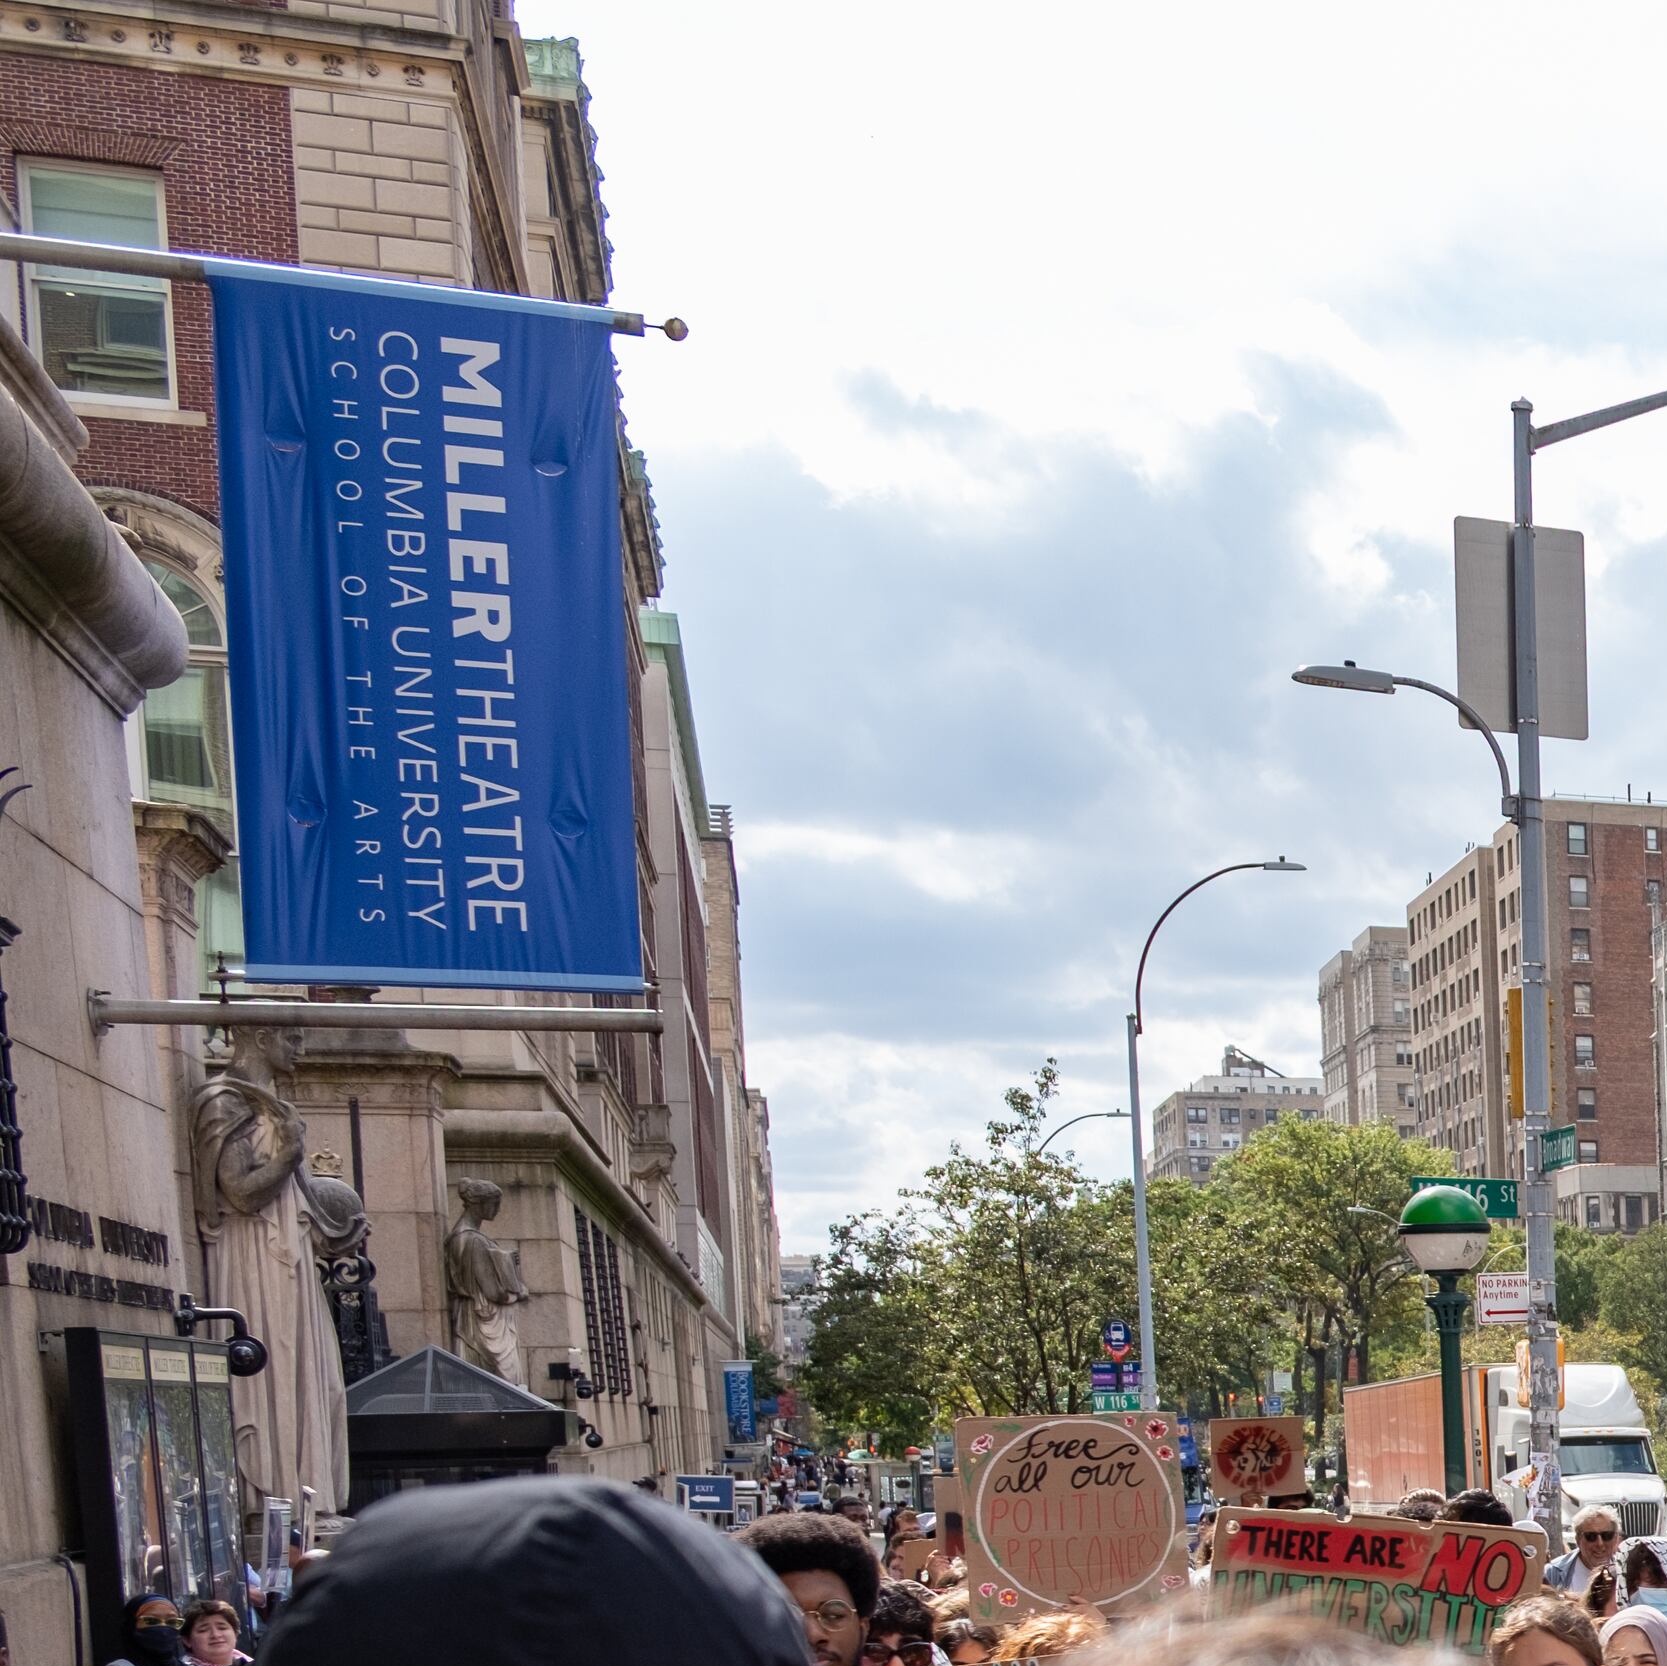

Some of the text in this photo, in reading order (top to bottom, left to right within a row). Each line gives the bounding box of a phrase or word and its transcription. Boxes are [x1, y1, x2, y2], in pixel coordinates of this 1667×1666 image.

[330, 326, 385, 924] SCHOOL OF THE ARTS
[378, 331, 446, 930] COLUMBIA UNIVERSITY
[1542, 1136, 1576, 1171] Broadway
[1500, 1185, 1516, 1203] St
[1482, 1279, 1528, 1289] NO PARKIN
[1483, 1290, 1519, 1300] Anytime
[1095, 1396, 1105, 1409] W
[1110, 1396, 1128, 1409] 116
[994, 1461, 1145, 1493] all our
[1005, 1530, 1161, 1597] PRISONERS
[1241, 1525, 1527, 1608] THERE ARE NO
